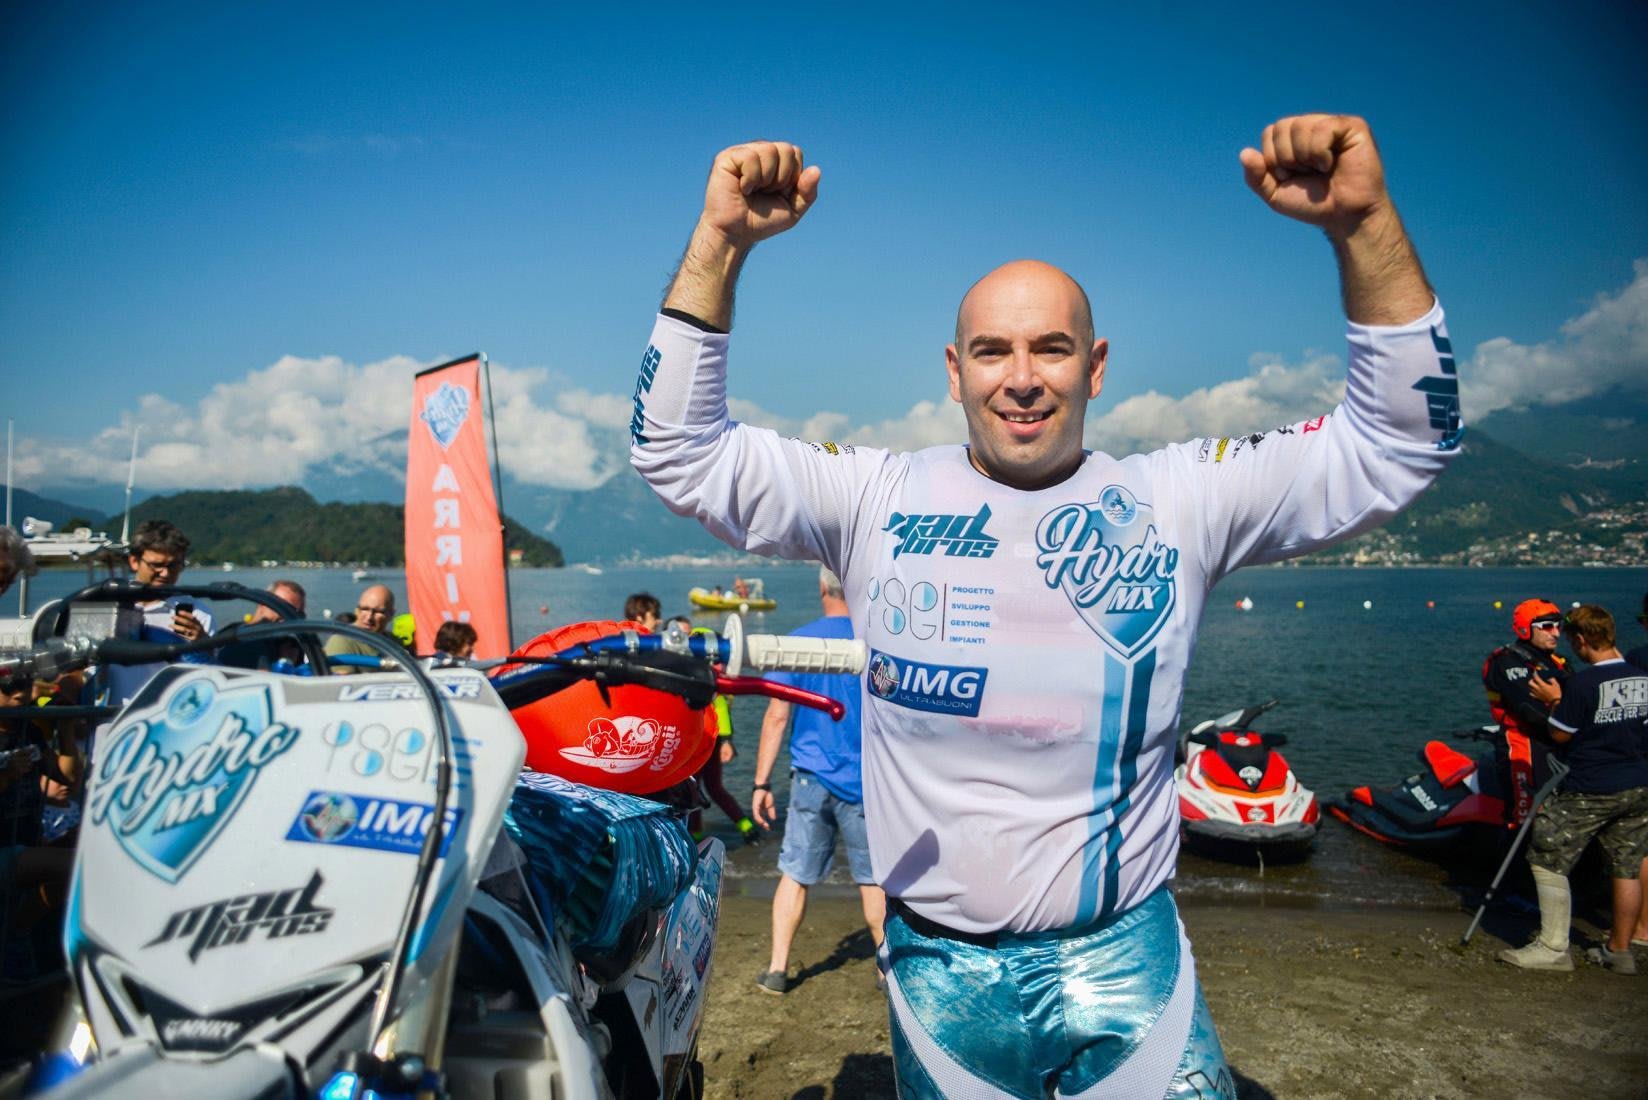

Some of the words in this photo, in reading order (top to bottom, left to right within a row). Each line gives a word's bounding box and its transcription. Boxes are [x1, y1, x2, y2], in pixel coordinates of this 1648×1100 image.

[951, 586, 995, 595] PROGETTO
[1106, 584, 1162, 614] MX
[951, 602, 991, 612] SVILUPPO
[950, 619, 991, 629] GESTIONE
[949, 635, 986, 645] IMPIANTI
[901, 664, 980, 699] IMG
[338, 683, 482, 702] VERAR
[153, 780, 231, 834] MX
